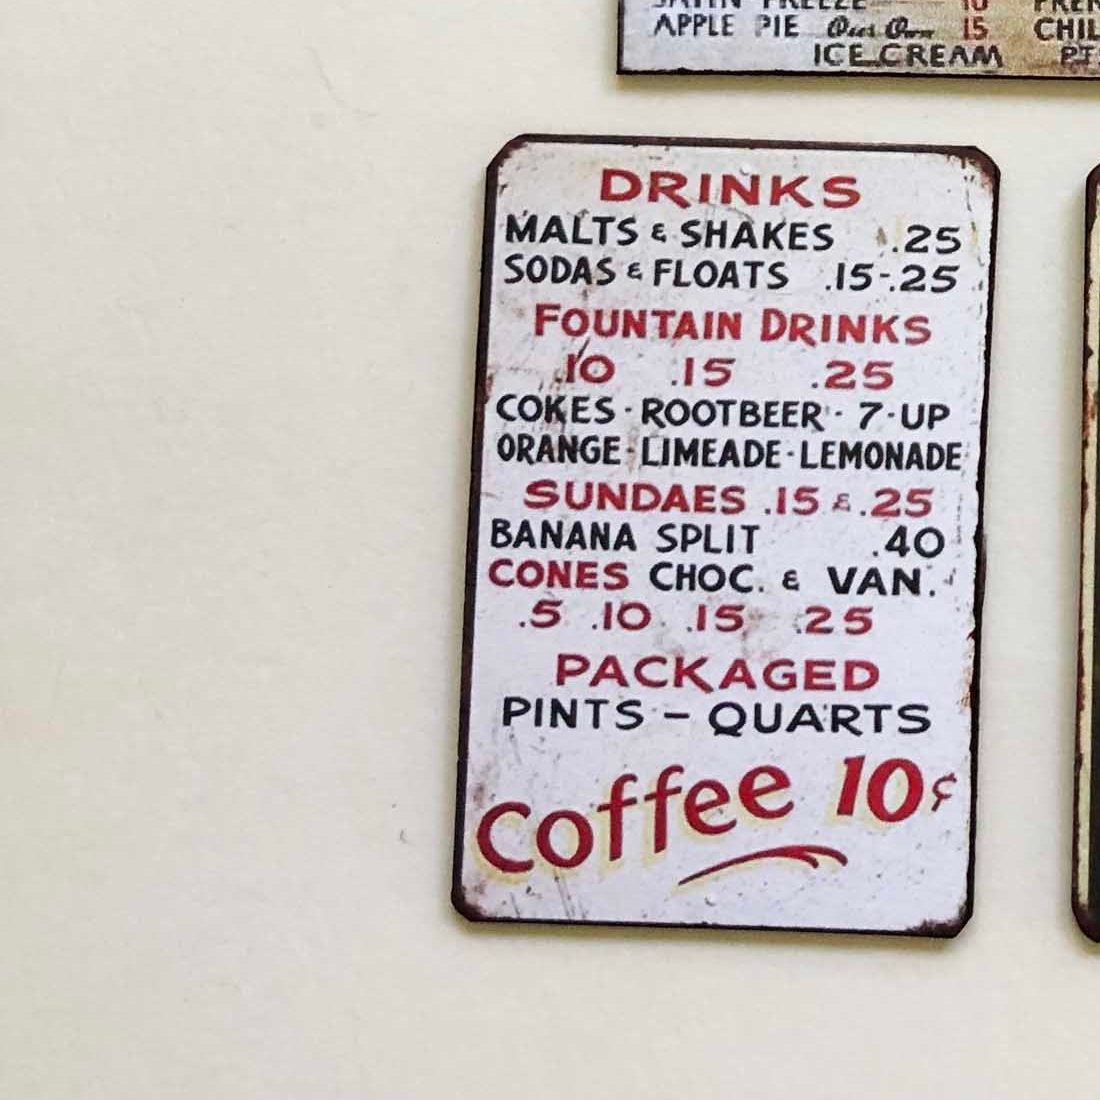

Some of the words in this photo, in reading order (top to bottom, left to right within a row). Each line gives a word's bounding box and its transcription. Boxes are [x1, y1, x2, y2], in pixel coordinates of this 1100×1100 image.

[600, 168, 861, 210] DRINKS
[505, 214, 638, 246] MALTS
[681, 219, 835, 252] SHAKES
[503, 254, 615, 286] SODAS
[654, 259, 789, 290] FLOATS
[534, 303, 740, 340] FOUNTAIN
[761, 308, 932, 346] DRINKS
[496, 394, 615, 424] COKES
[523, 479, 746, 513] SUNDAES
[490, 519, 636, 551] BANANA
[656, 523, 760, 553] SPLIT
[488, 558, 629, 590] CONES
[556, 653, 880, 693] PACKAGED
[502, 697, 644, 729] PINTS
[708, 702, 932, 737] QUARTS
